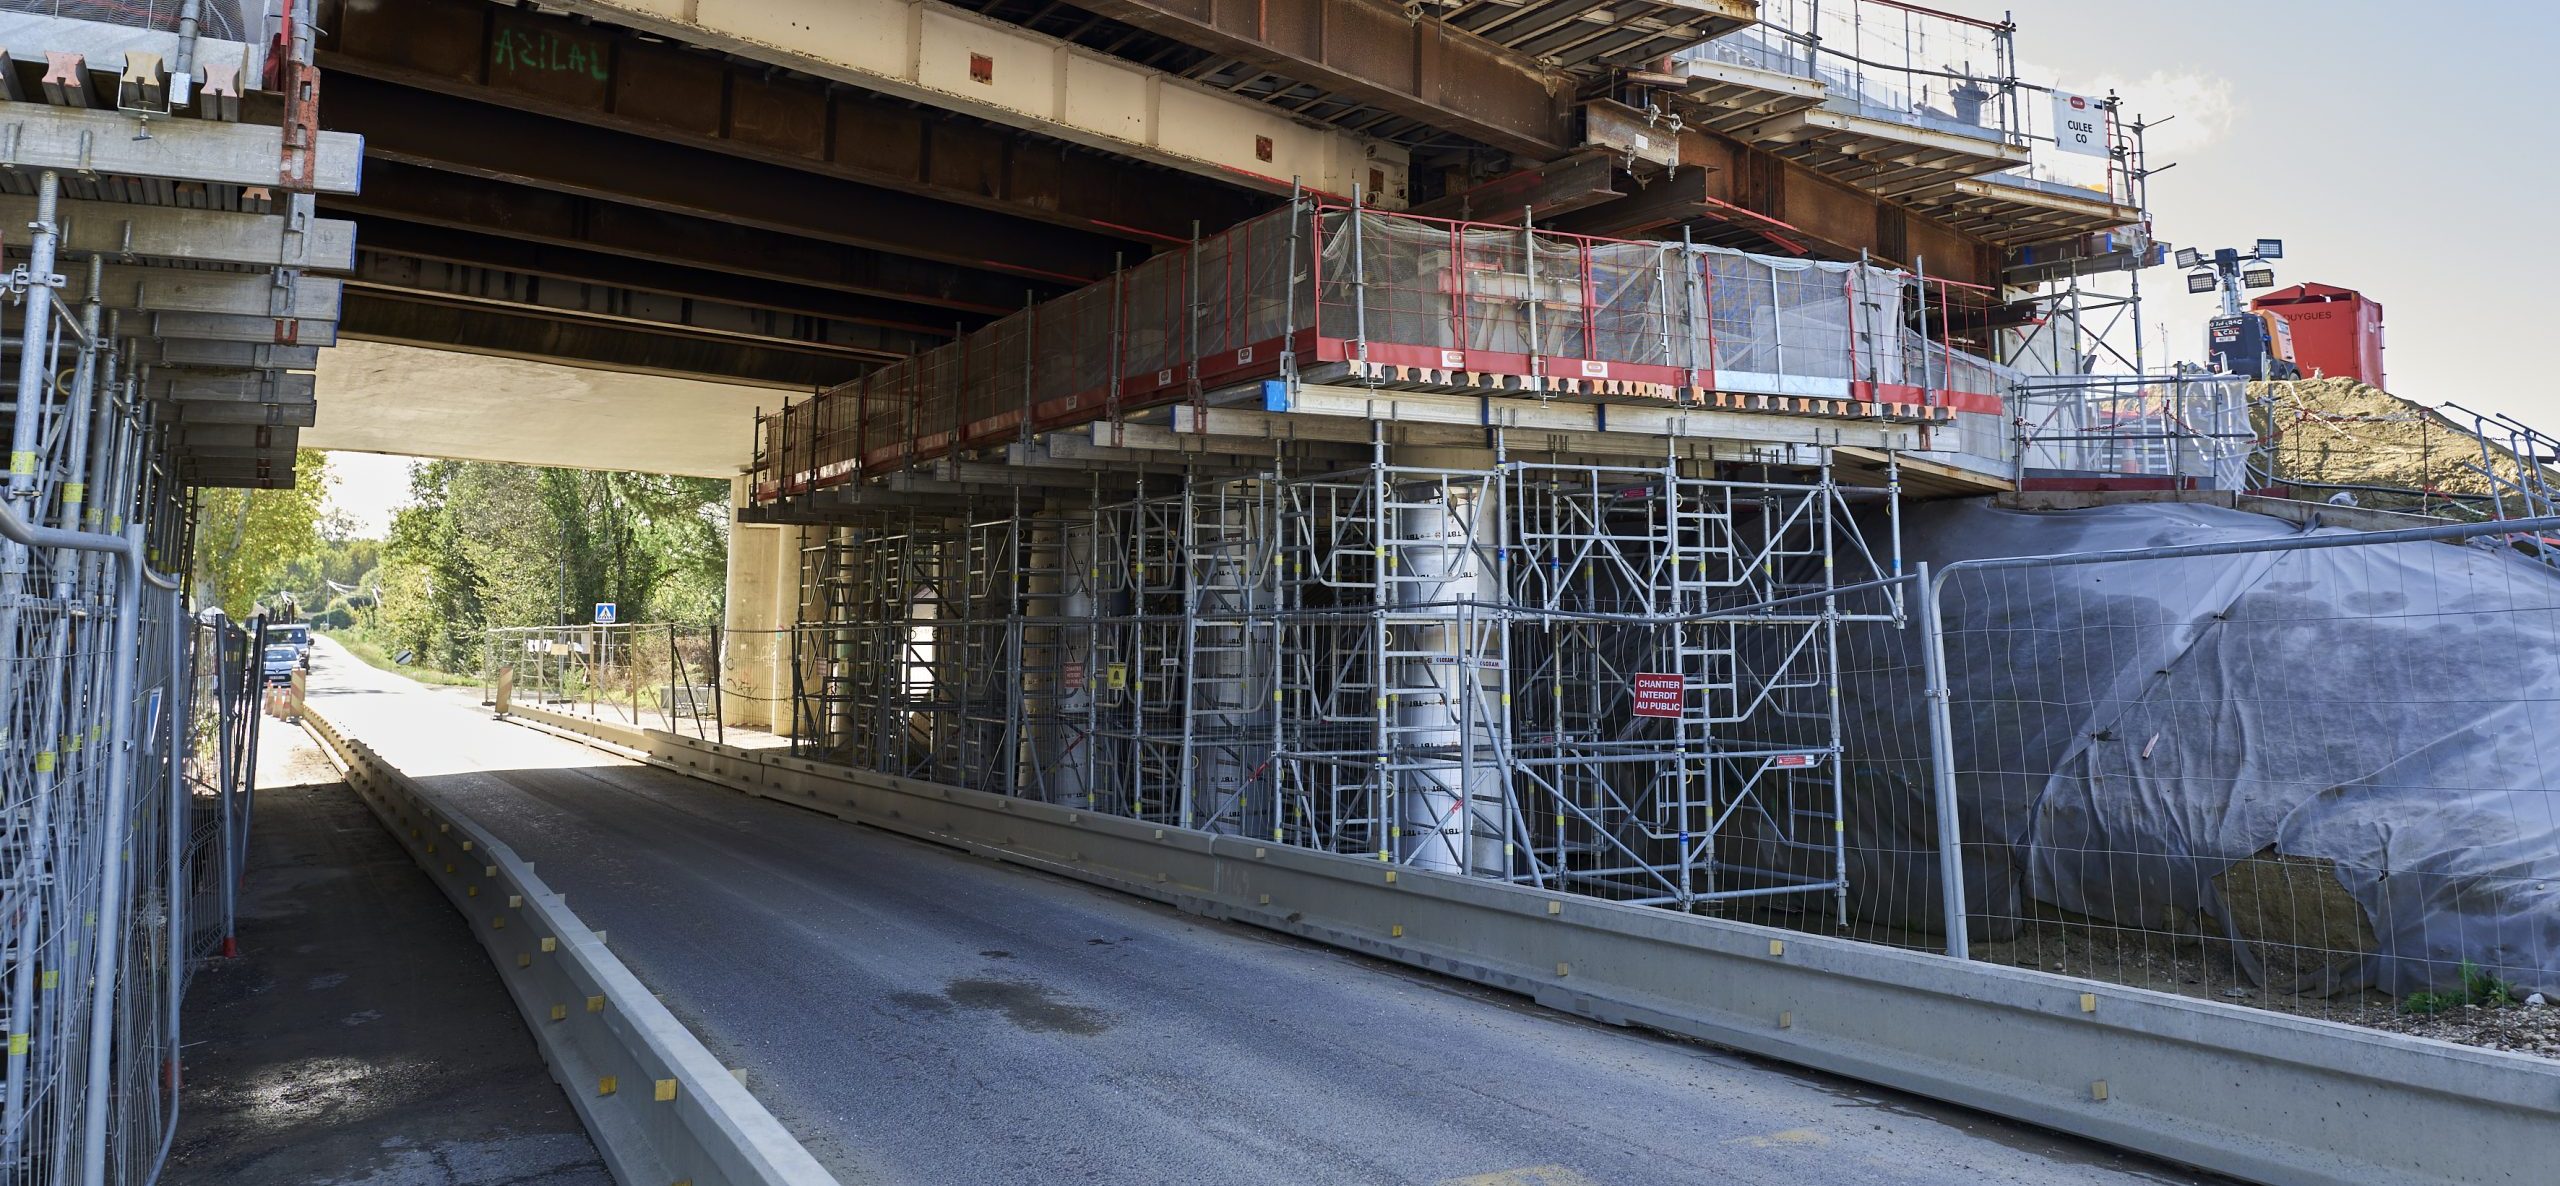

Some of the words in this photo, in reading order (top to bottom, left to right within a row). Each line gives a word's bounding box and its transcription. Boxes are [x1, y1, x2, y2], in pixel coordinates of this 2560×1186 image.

[2067, 120, 2093, 133] CULEE
[2284, 311, 2332, 322] OUYGUES
[1638, 680, 1680, 689] CHANTIER
[1639, 690, 1678, 700] INTERDIT
[1636, 701, 1648, 709] AU
[1650, 701, 1681, 711] PUBLIC
